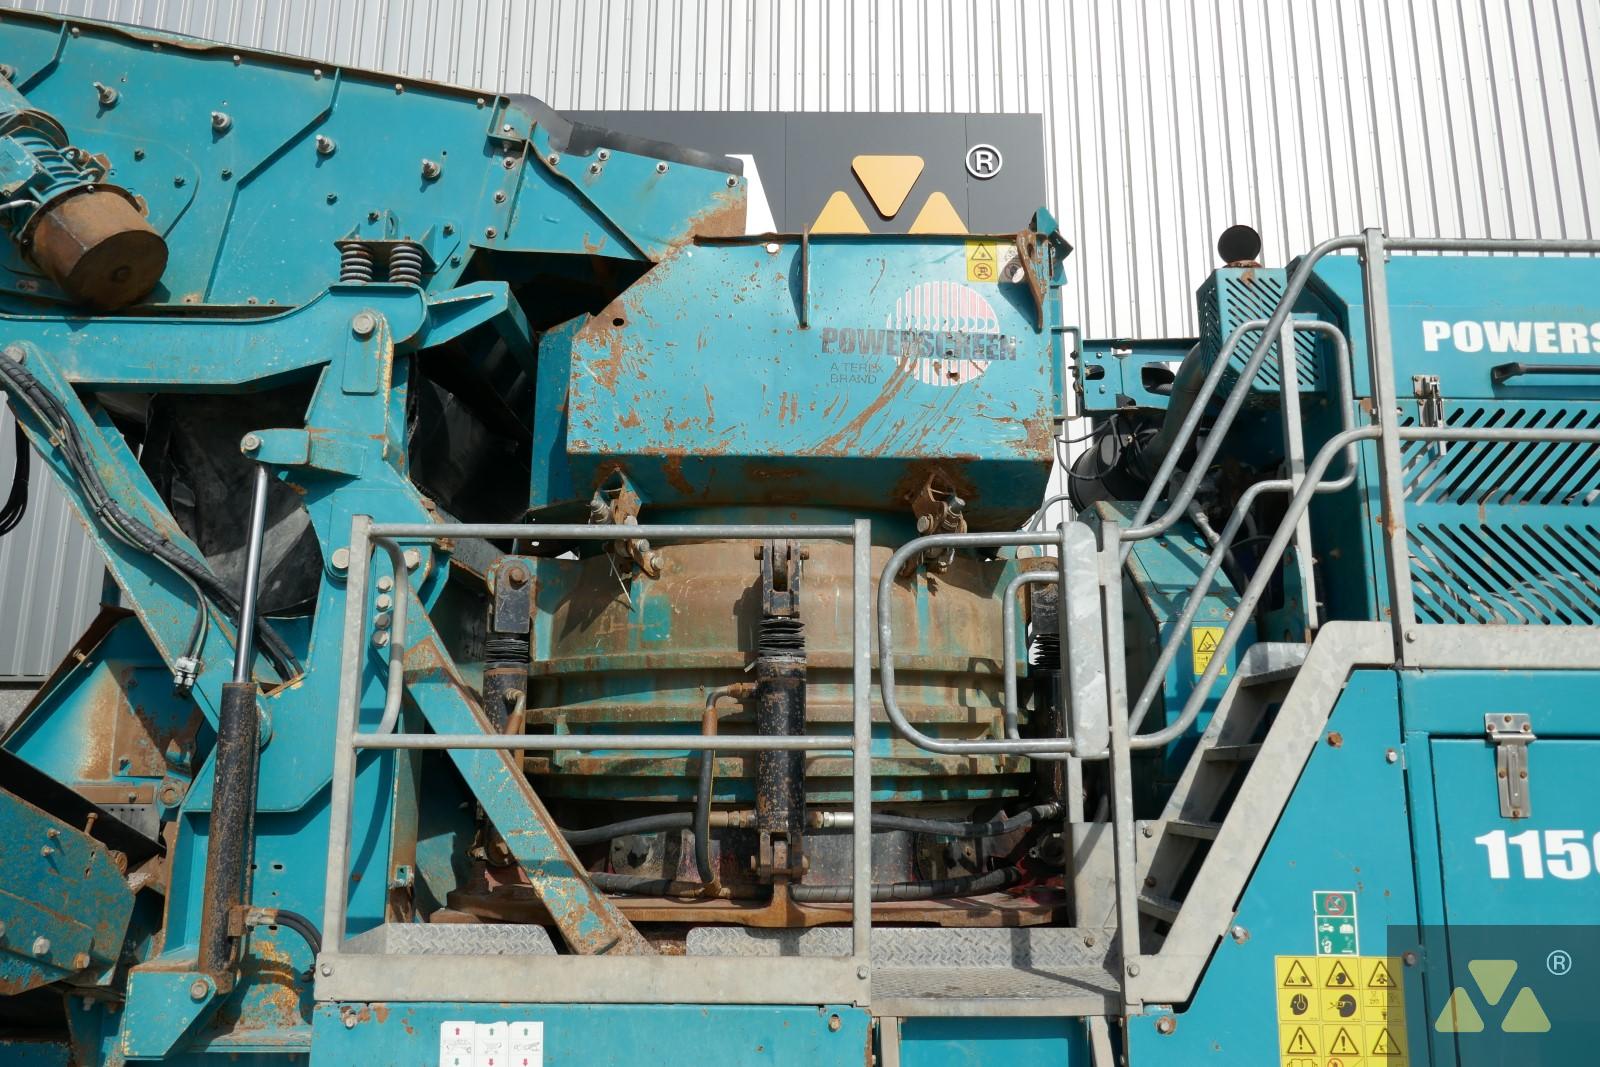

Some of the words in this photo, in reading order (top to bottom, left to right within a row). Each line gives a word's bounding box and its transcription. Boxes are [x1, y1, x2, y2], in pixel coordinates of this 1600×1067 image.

[821, 327, 1017, 361] POWERSCREEN
[830, 374, 877, 385] BRAND
[1474, 829, 1600, 880] 115
